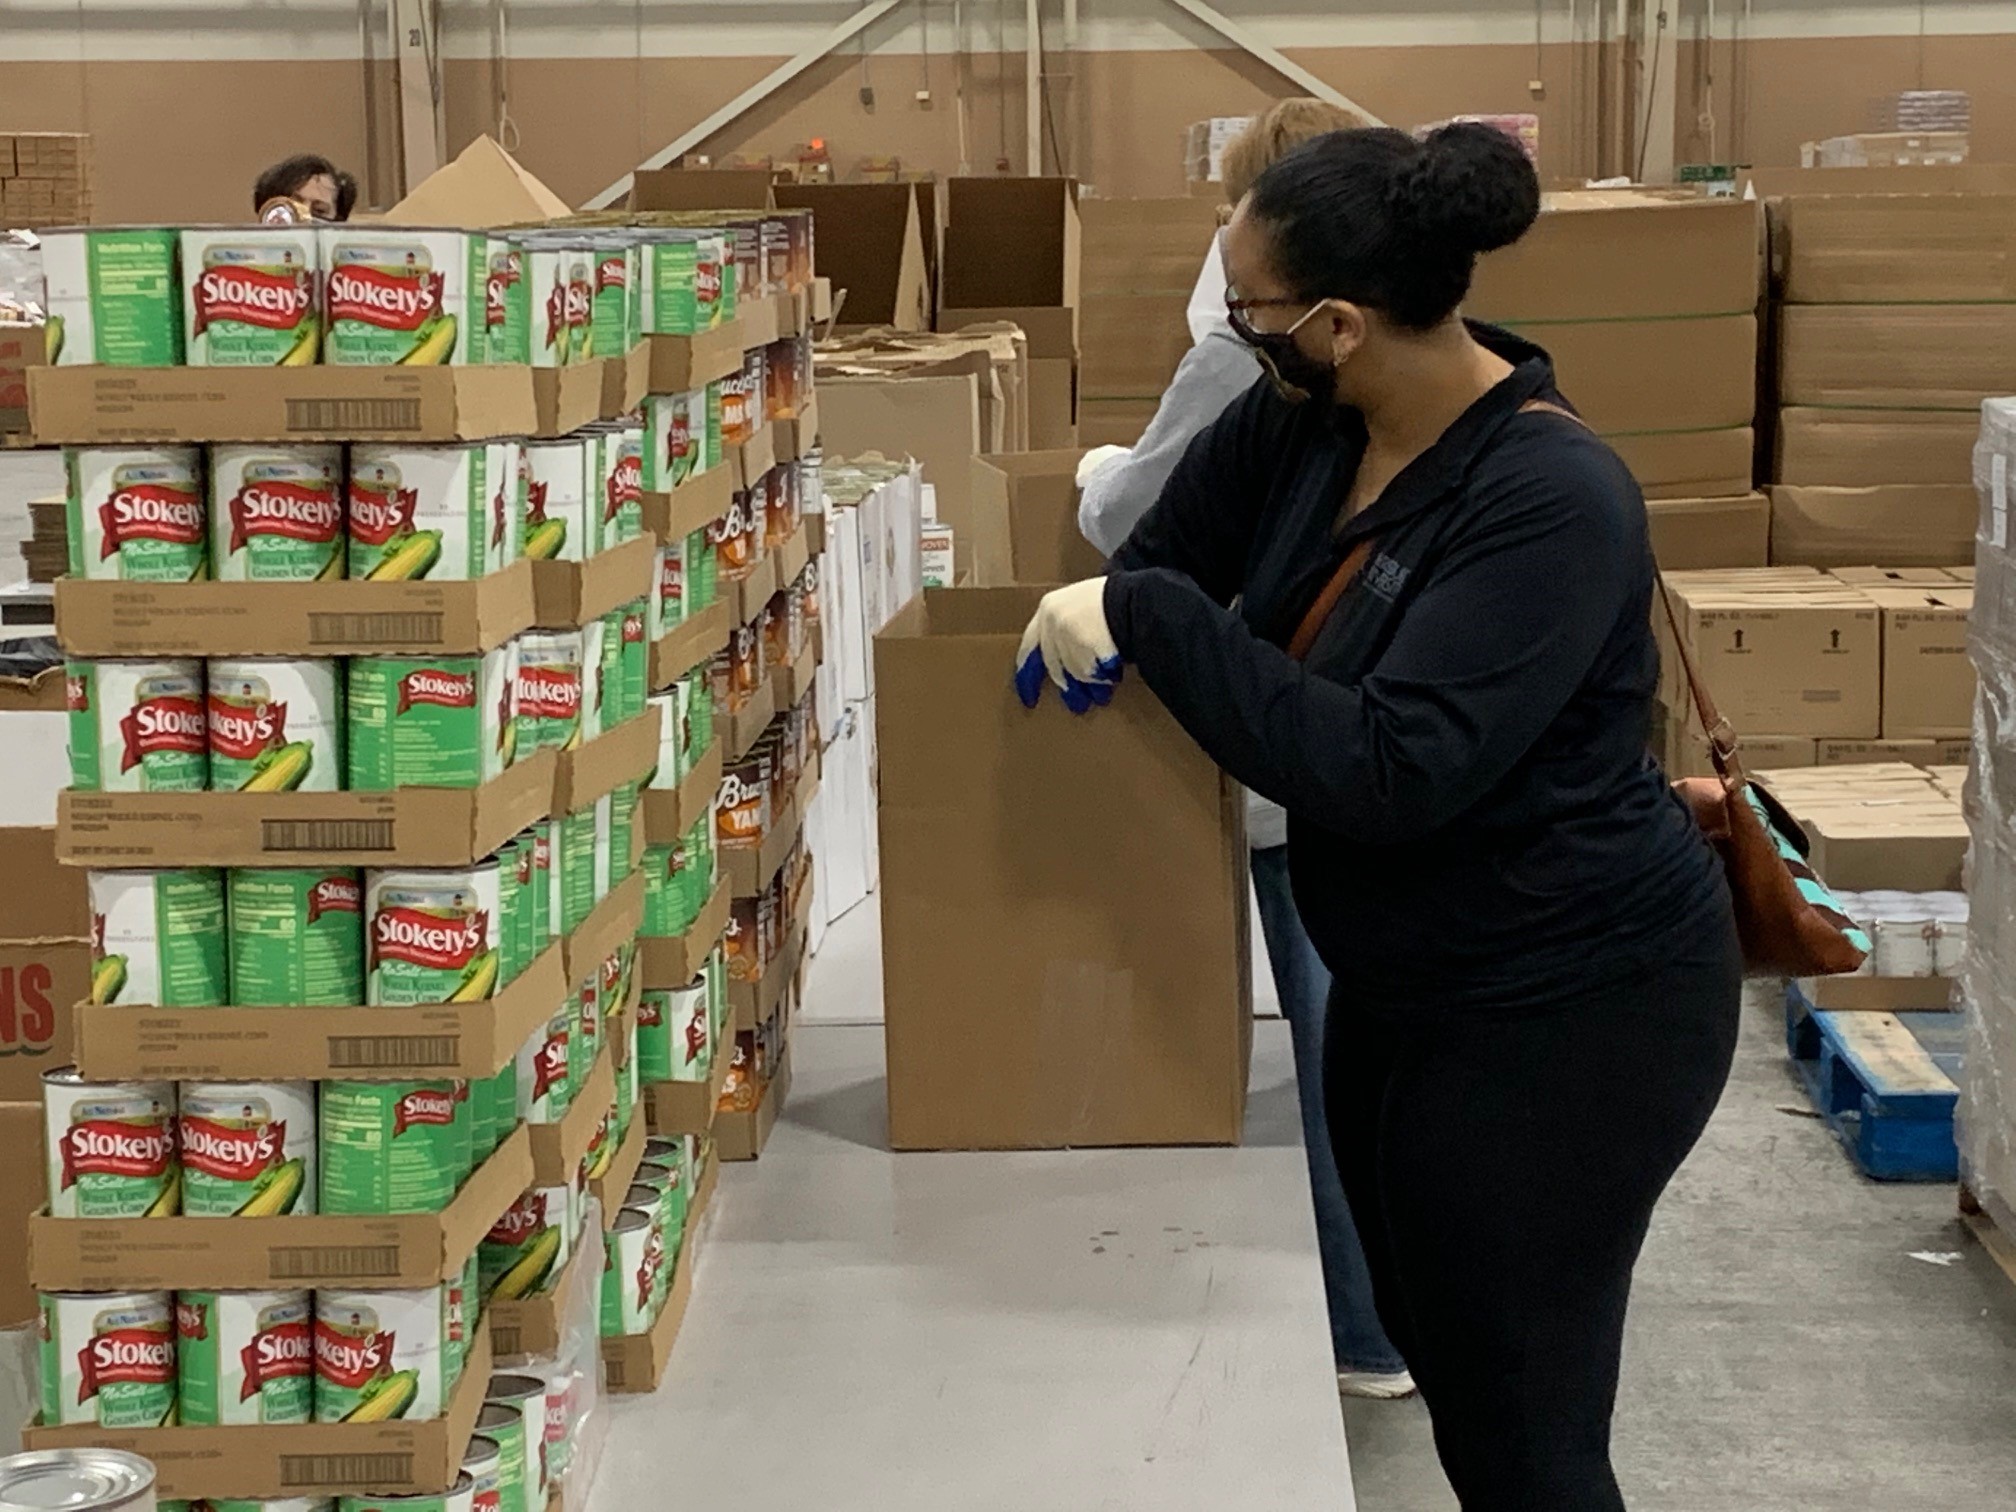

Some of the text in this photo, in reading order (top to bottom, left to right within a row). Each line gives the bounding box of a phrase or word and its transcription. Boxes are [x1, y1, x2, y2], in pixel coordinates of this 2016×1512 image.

[203, 272, 309, 316] Stokely's
[331, 272, 437, 317] Stokely's
[377, 913, 482, 957] Stokely's
